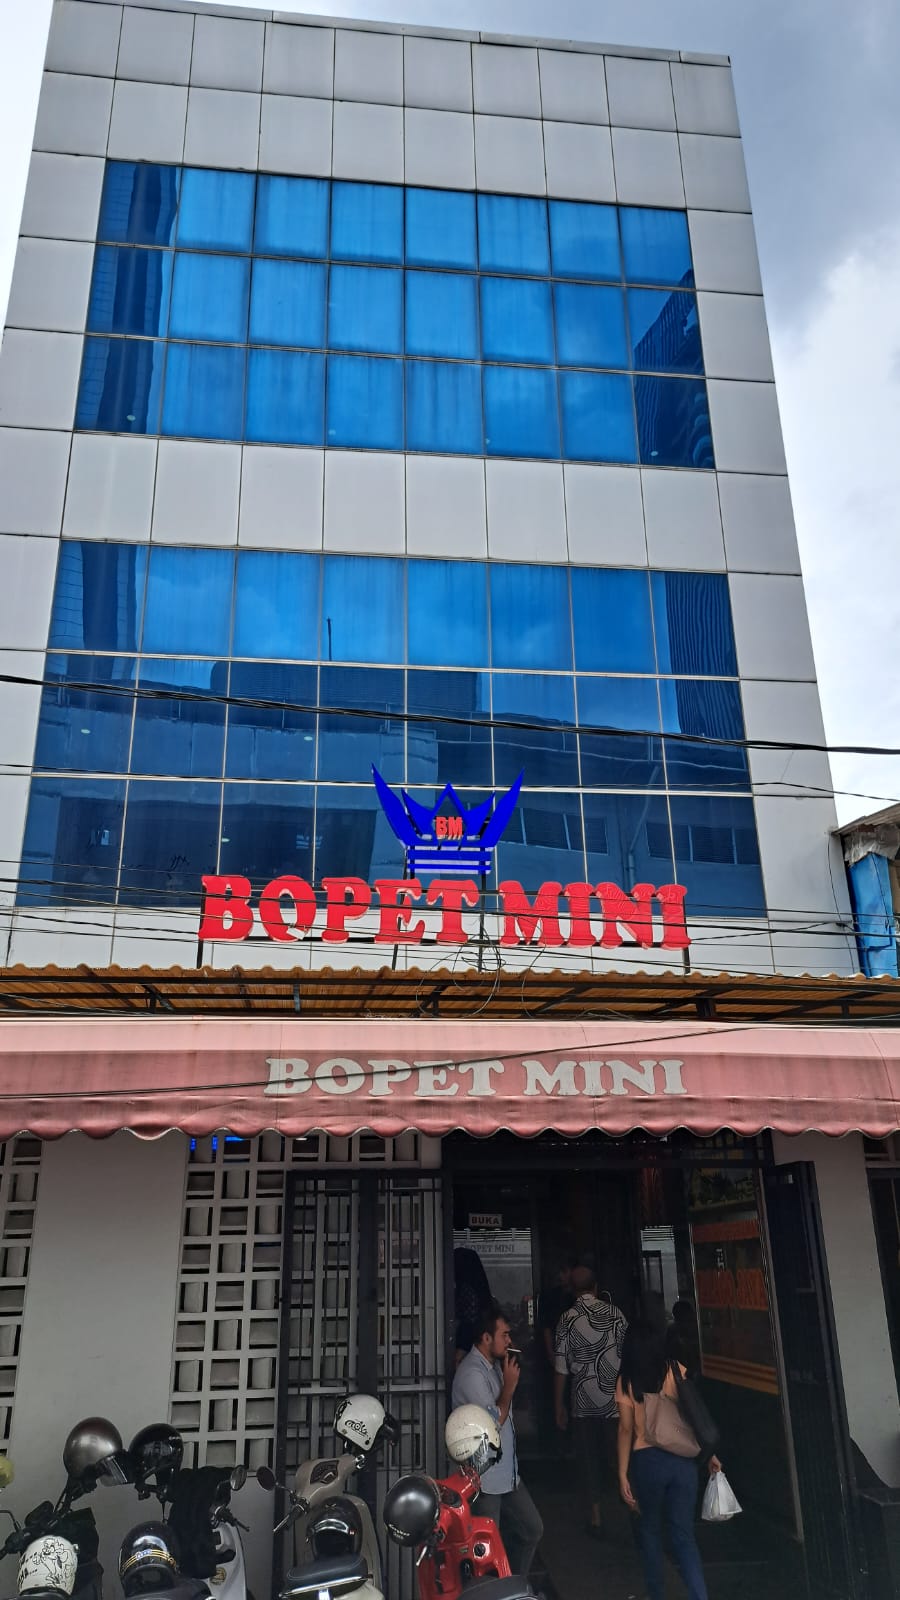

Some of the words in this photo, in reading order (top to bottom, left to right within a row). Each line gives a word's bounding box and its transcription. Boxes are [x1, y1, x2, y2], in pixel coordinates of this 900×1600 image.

[436, 816, 463, 839] BM
[198, 875, 479, 945] BOPET
[499, 881, 692, 950] MINI
[264, 1057, 505, 1097] BOPET
[522, 1060, 688, 1096] MINI
[471, 1216, 500, 1225] BUKA
